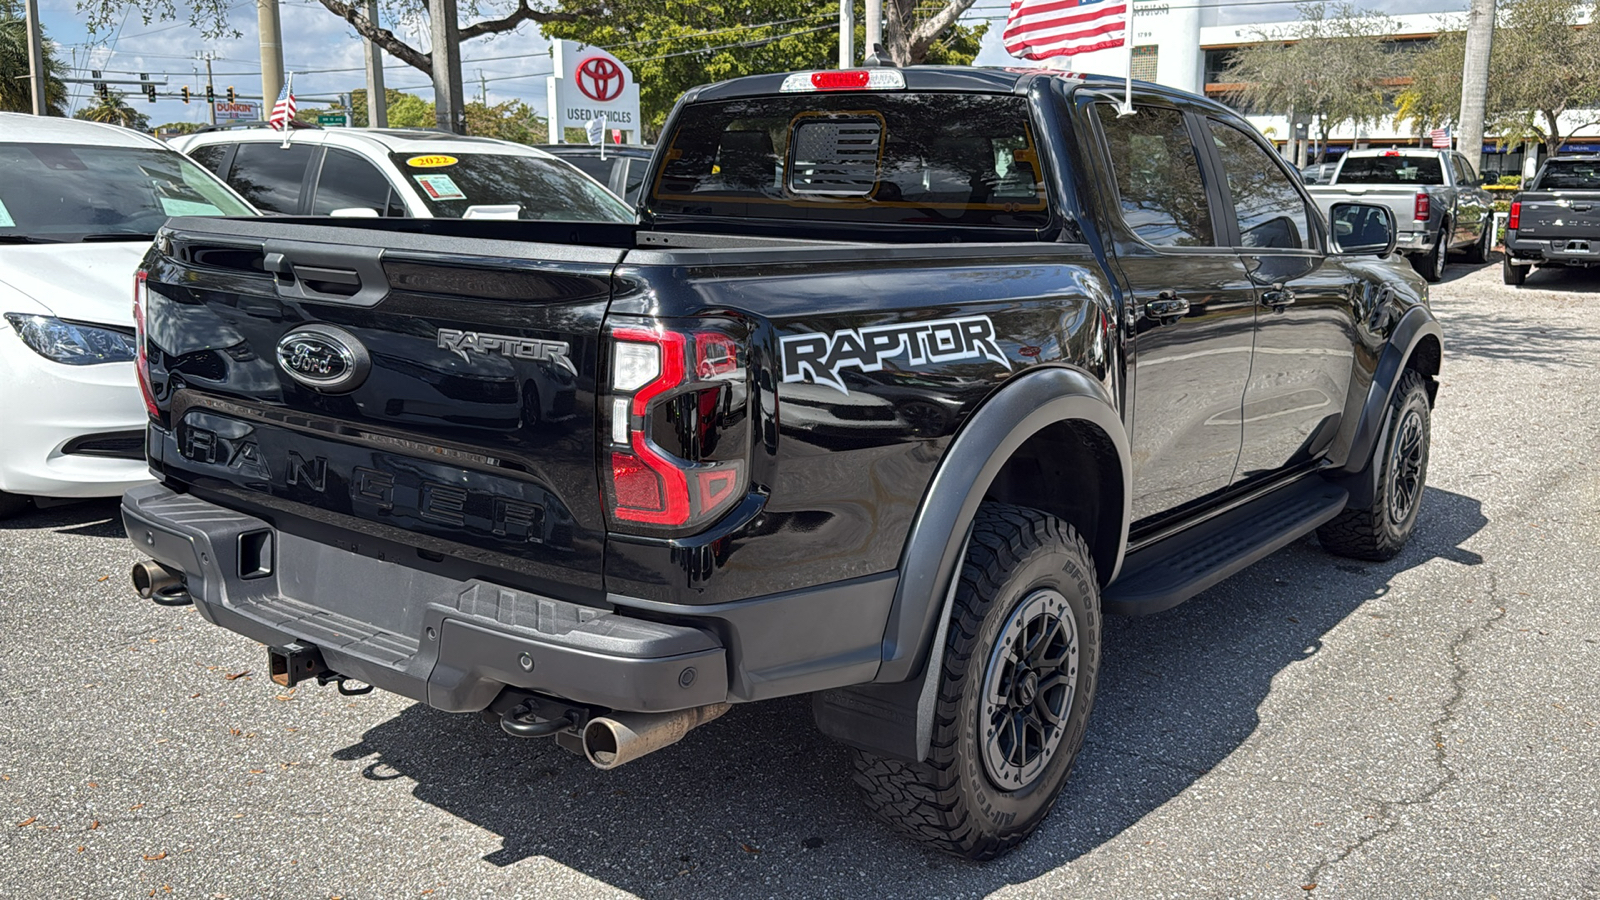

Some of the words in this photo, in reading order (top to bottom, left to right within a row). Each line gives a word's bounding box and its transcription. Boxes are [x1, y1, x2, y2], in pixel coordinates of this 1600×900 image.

[567, 108, 591, 121] USED
[593, 109, 631, 123] VEHICLES
[417, 157, 450, 166] 2022
[291, 342, 332, 374] Ford
[437, 328, 578, 377] RAPTOR
[779, 314, 1013, 397] RAPTOR
[184, 423, 545, 544] RANGER
